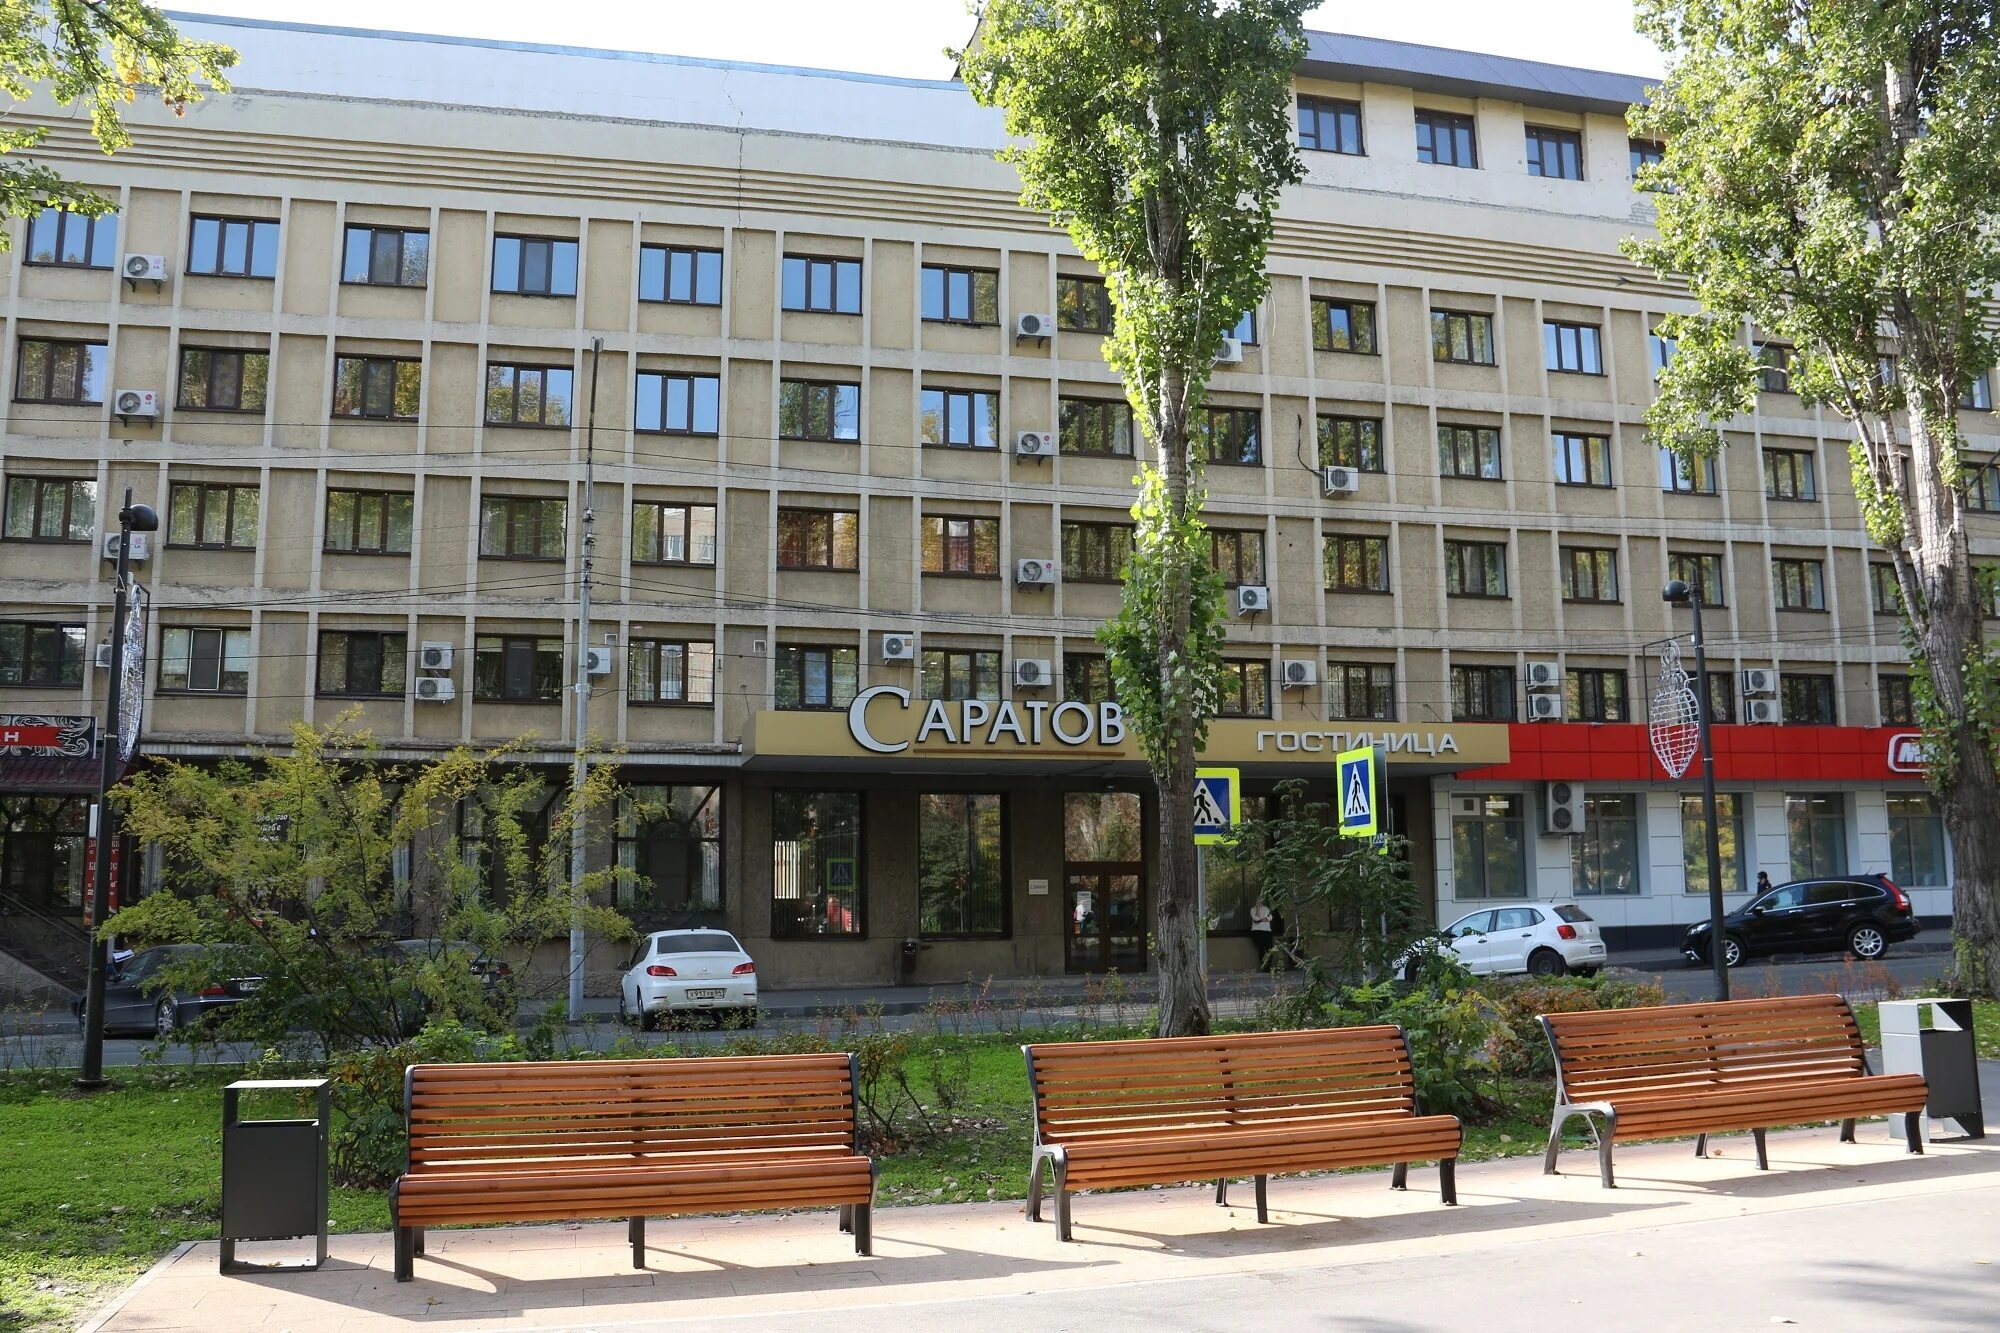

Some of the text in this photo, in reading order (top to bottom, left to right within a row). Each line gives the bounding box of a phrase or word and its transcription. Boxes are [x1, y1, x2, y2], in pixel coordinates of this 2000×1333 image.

[848, 684, 1126, 753] САРАТОВ
[0, 731, 19, 742] Н
[1257, 731, 1460, 757] ГОСТИНИЦА
